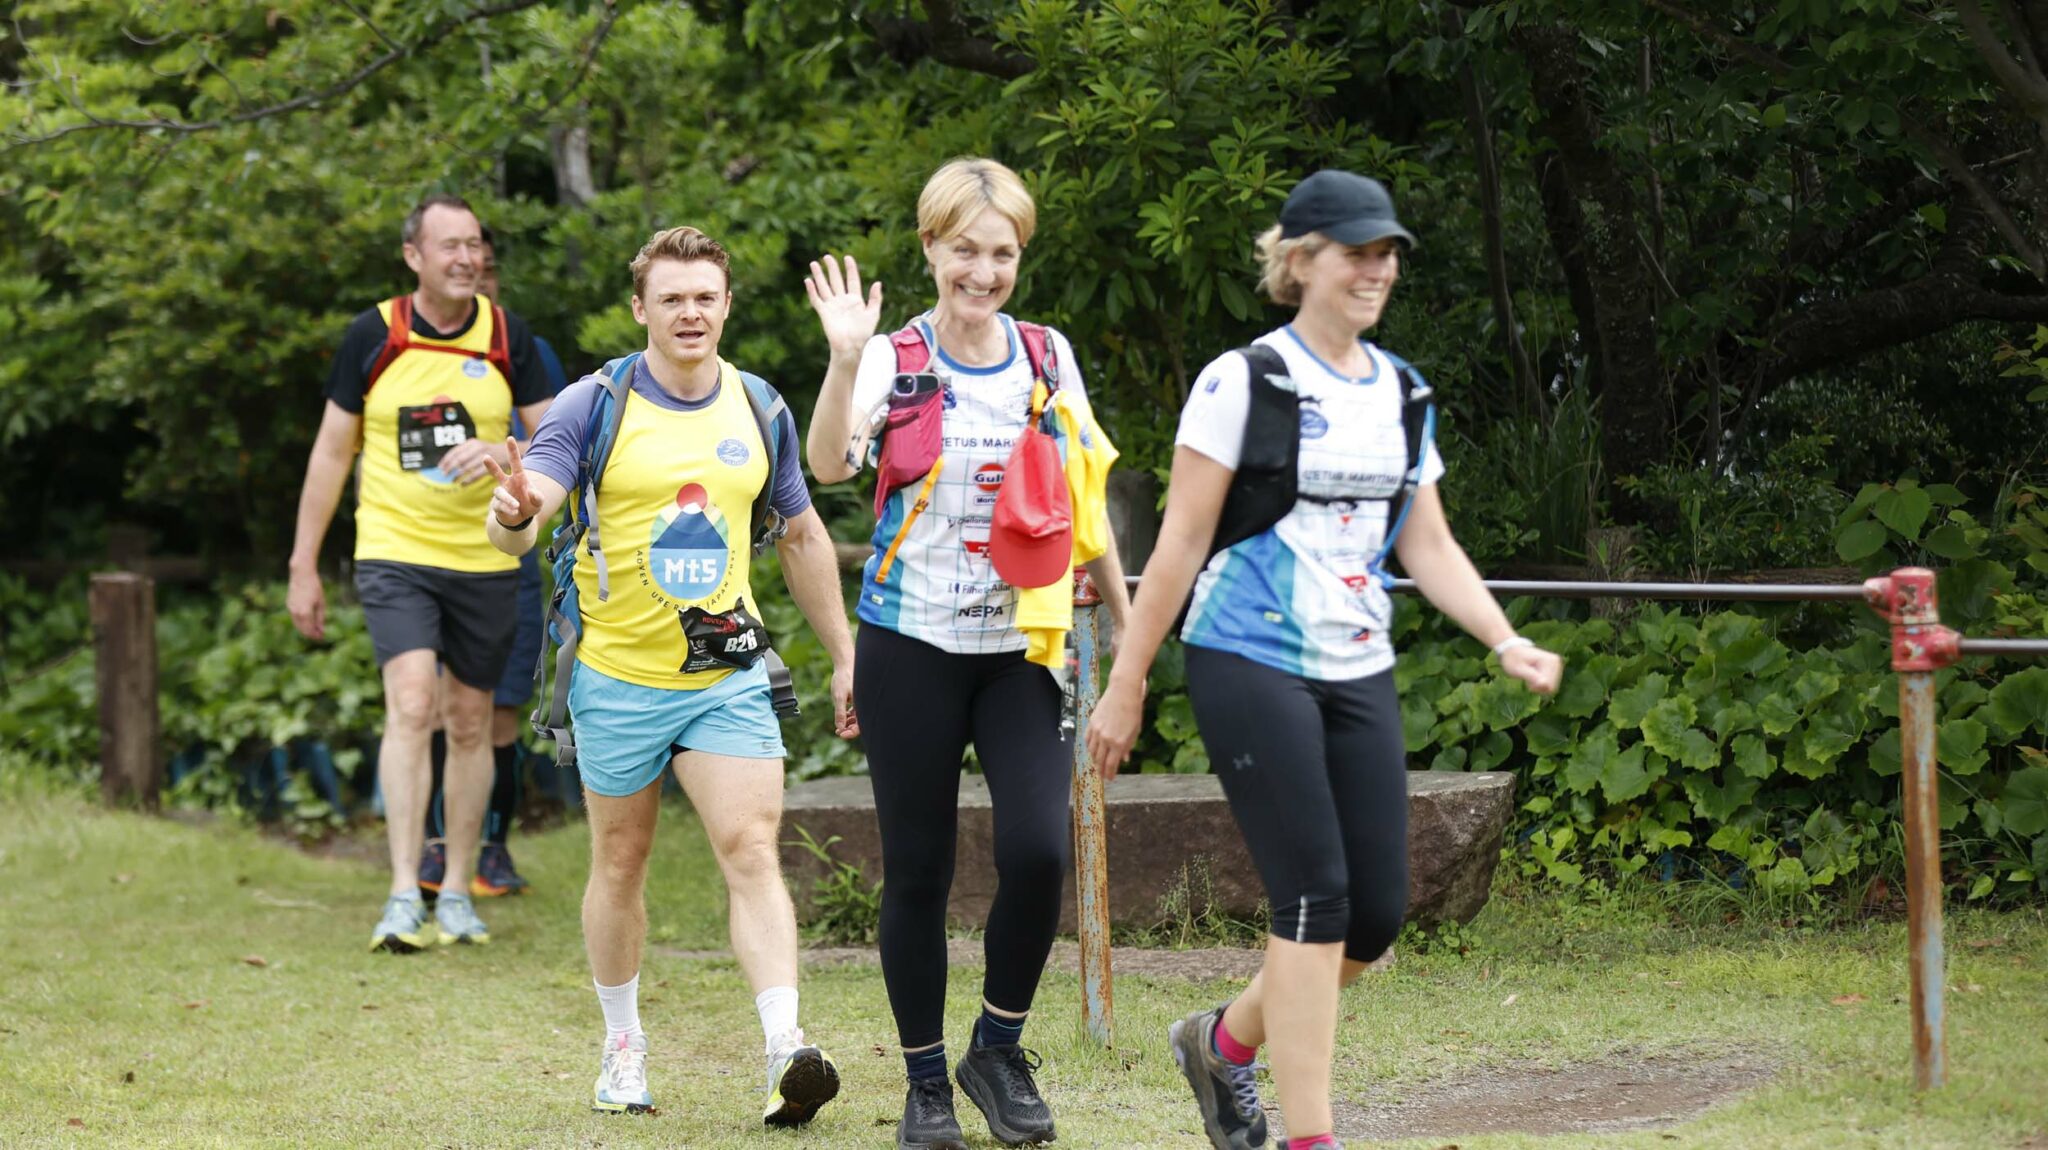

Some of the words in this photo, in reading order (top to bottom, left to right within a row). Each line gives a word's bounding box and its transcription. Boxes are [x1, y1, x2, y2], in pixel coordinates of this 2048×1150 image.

[942, 437, 977, 448] ETUS
[663, 558, 718, 584] Mt5
[958, 606, 1004, 618] NEPA
[723, 628, 758, 653] B26
